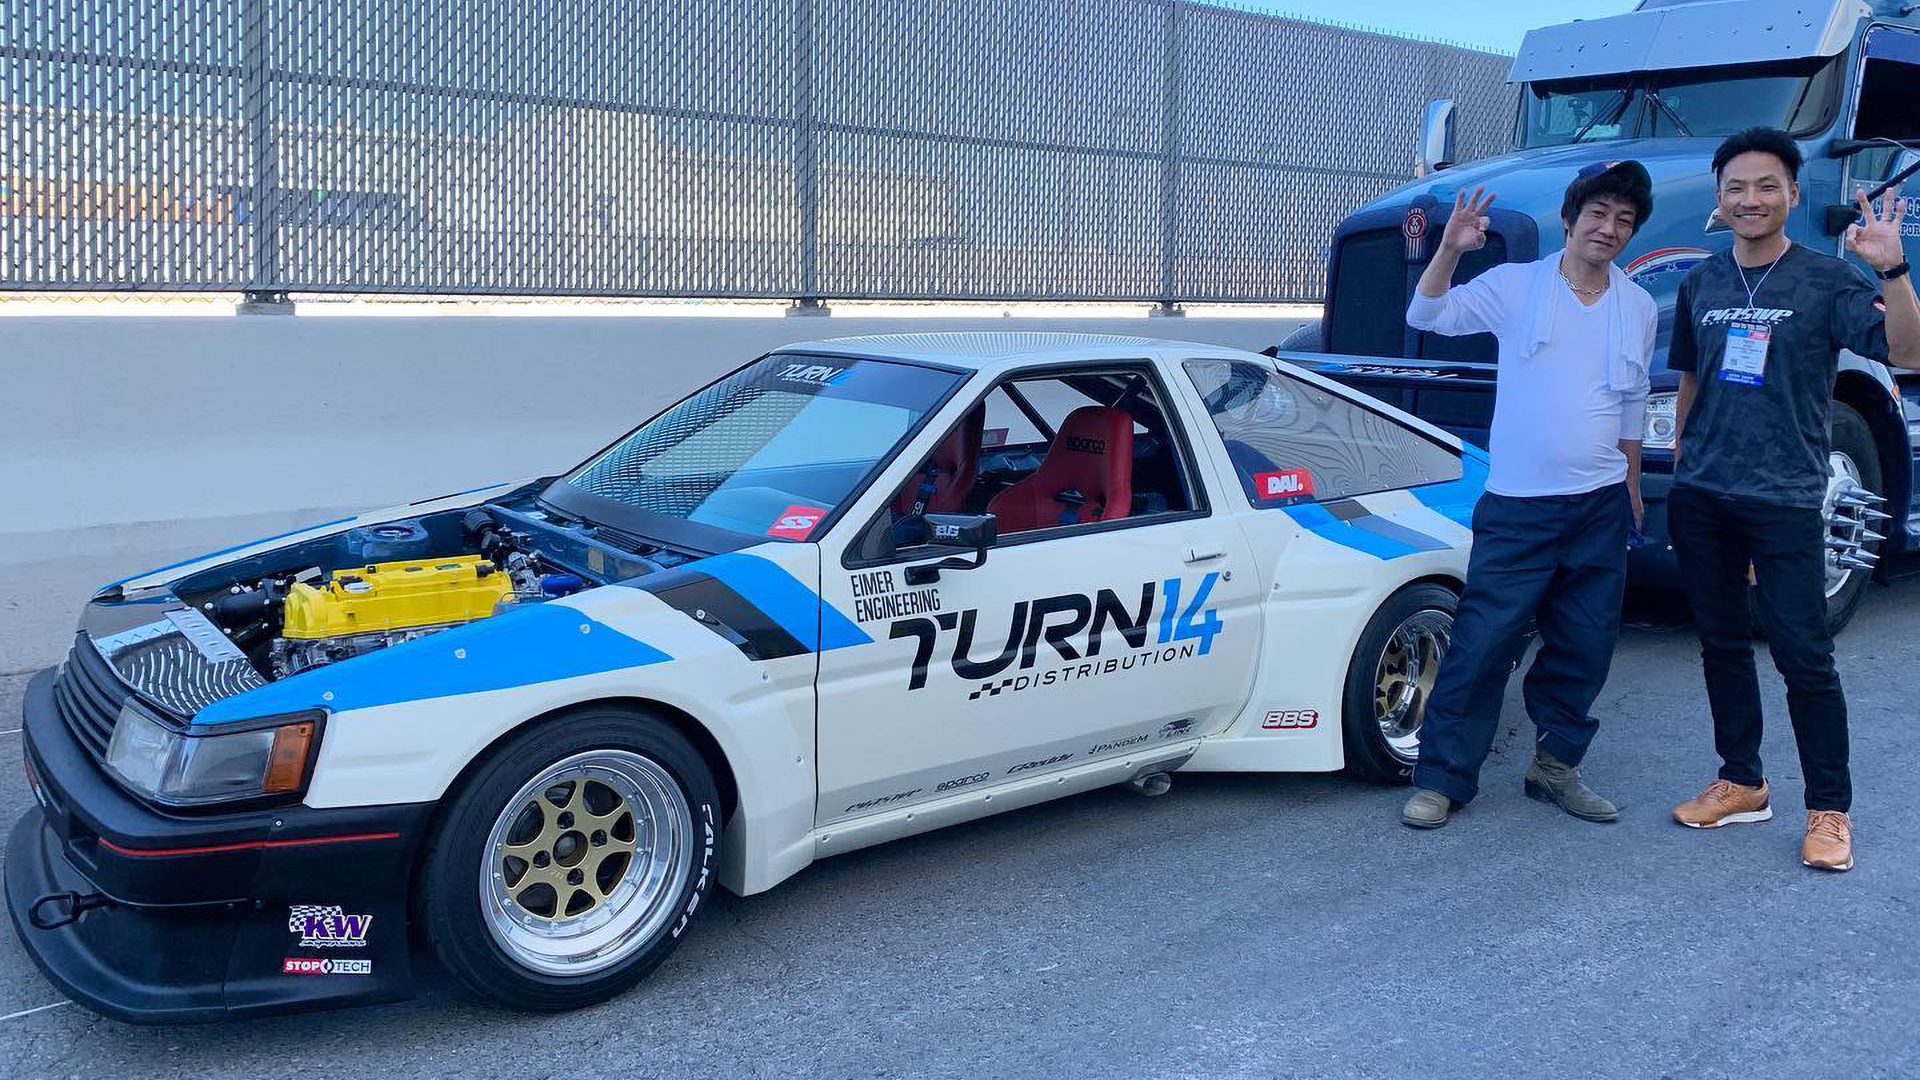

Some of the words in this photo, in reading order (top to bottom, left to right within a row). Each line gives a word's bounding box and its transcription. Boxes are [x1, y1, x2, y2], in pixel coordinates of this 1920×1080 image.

[850, 570, 895, 597] EIMER
[854, 588, 941, 623] ENGINEERING
[1012, 644, 1195, 692] DISTRIBUTION
[1262, 710, 1319, 729] BBS
[934, 771, 990, 793] sparco
[672, 803, 714, 938] FALKEN
[301, 914, 373, 940] KW
